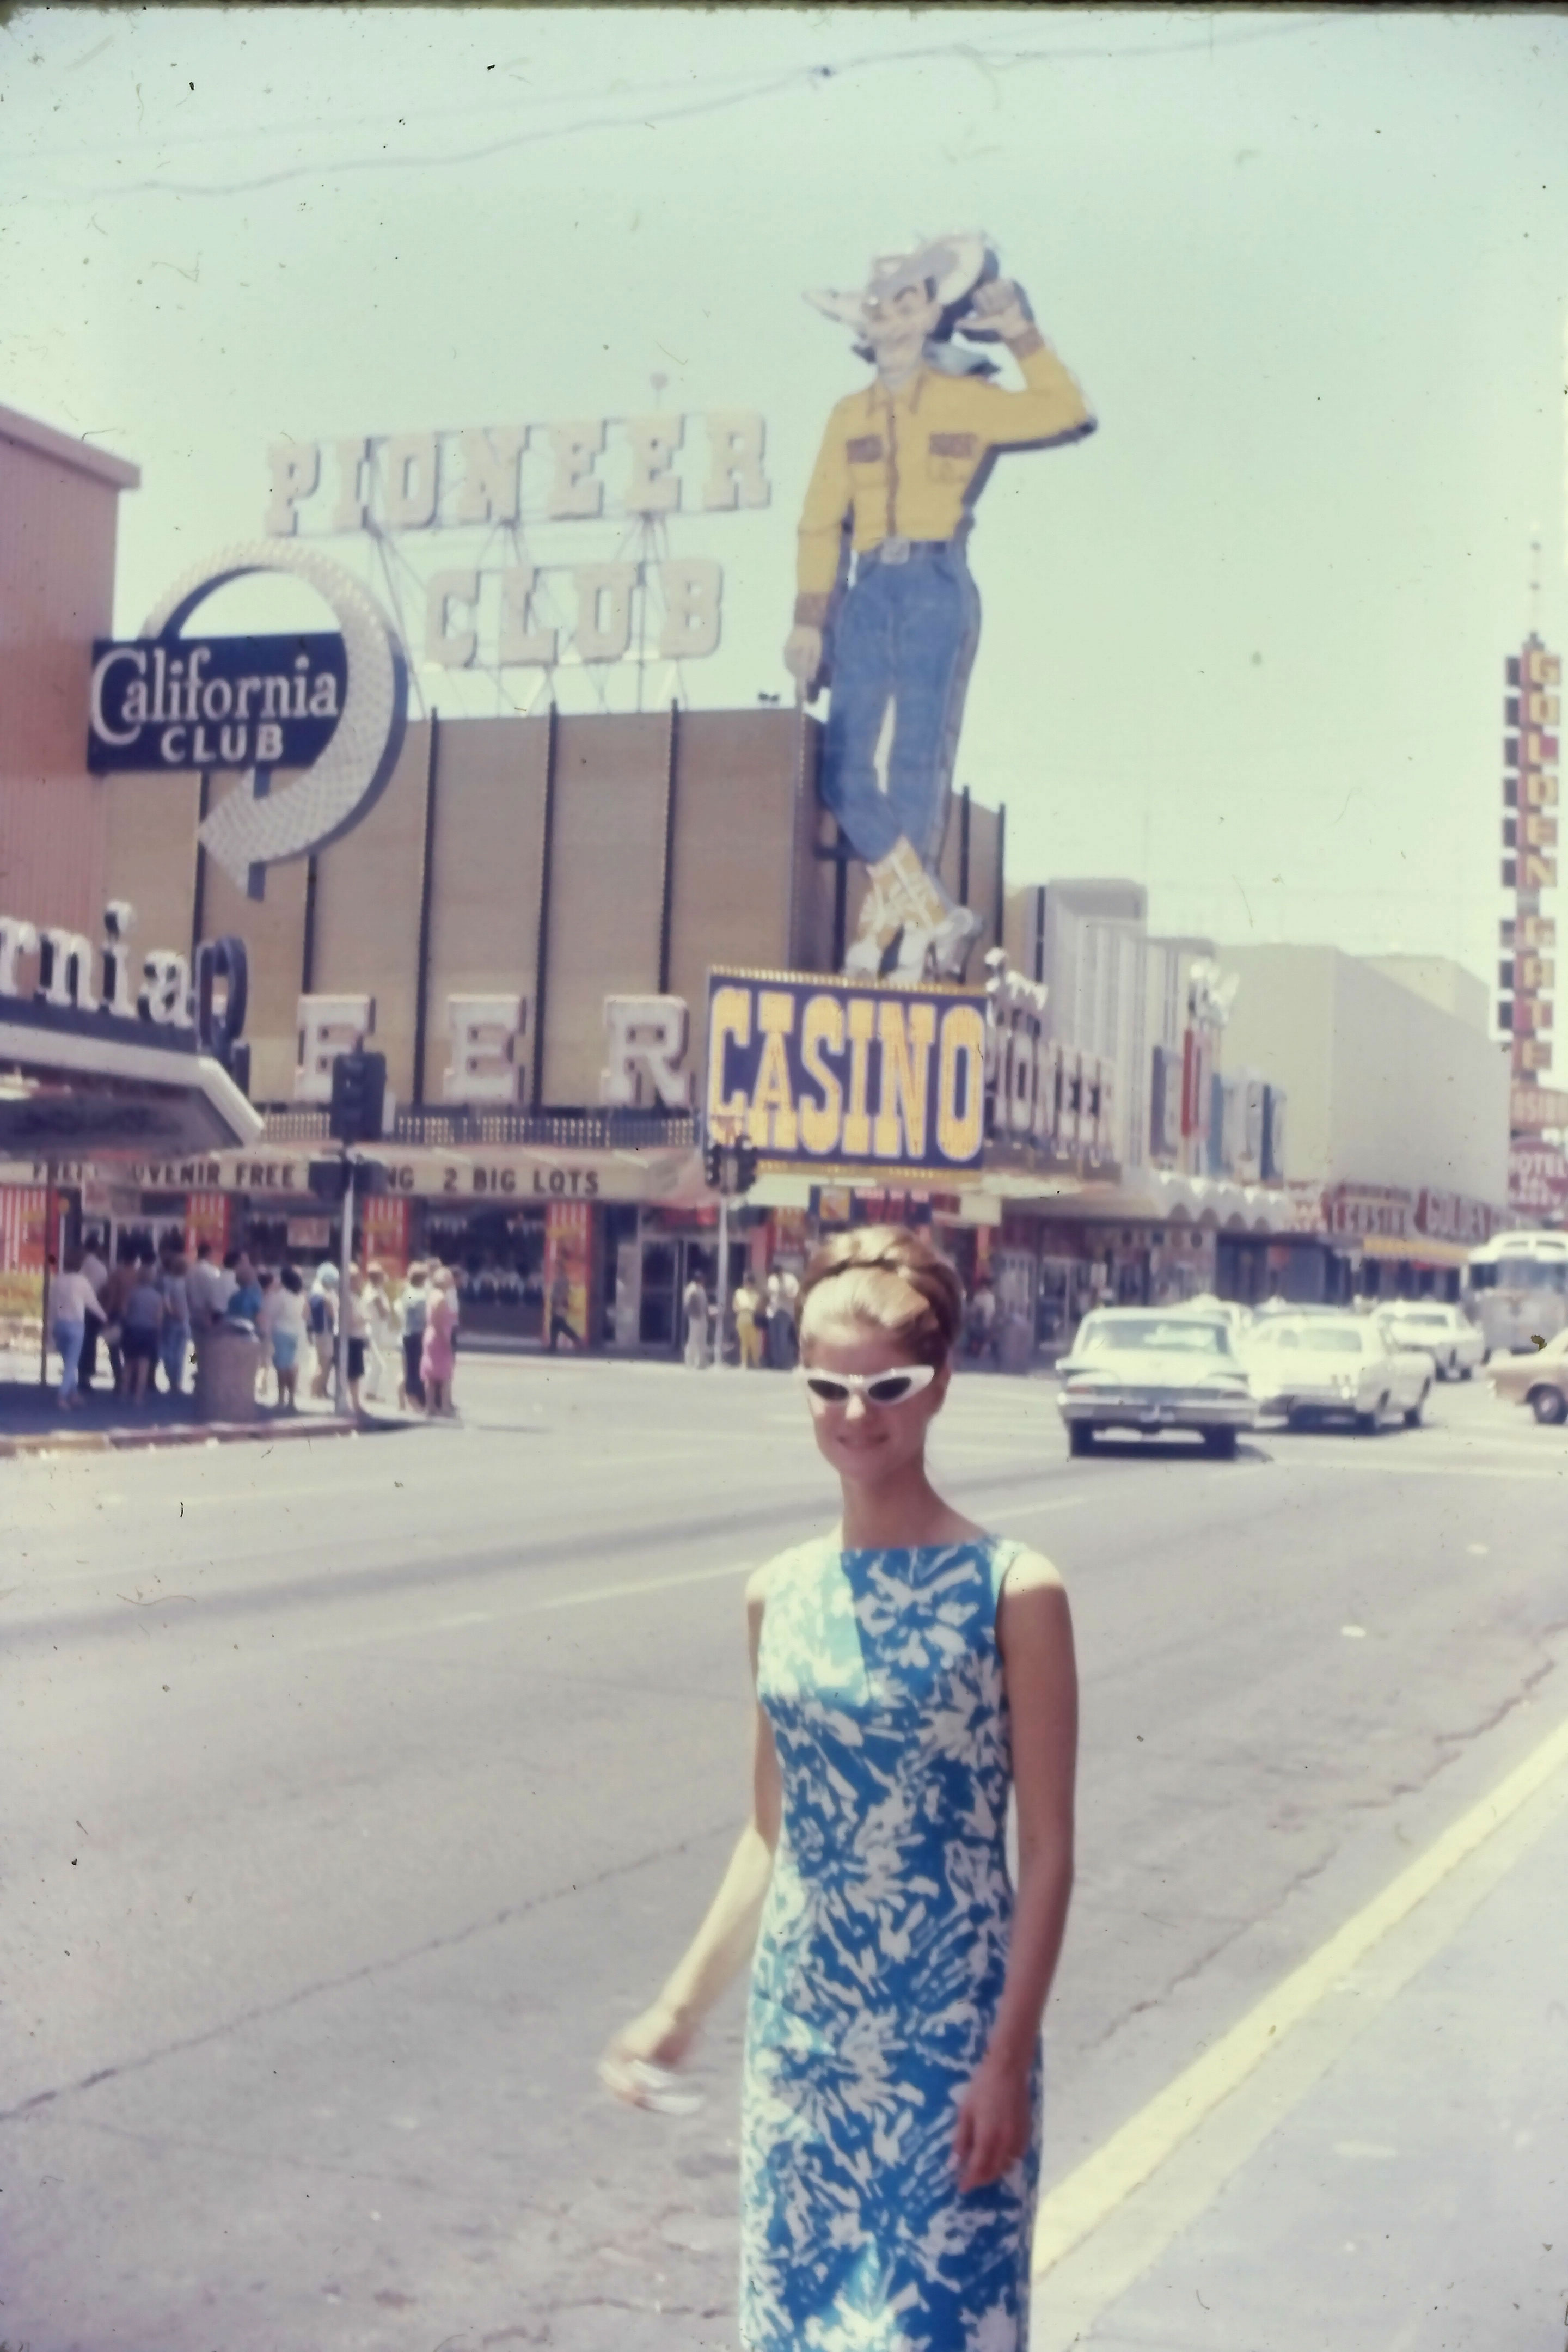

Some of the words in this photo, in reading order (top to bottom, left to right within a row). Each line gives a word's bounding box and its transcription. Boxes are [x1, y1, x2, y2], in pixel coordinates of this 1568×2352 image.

[266, 409, 772, 536] PIONEER
[426, 559, 724, 670] CLUB
[90, 647, 339, 745] California
[161, 722, 284, 762] CLUB
[709, 984, 984, 1162] CASINO
[236, 1162, 295, 1189] FREE
[443, 1168, 458, 1192] 2
[473, 1168, 516, 1193] BIG
[533, 1169, 599, 1196] LOTS
